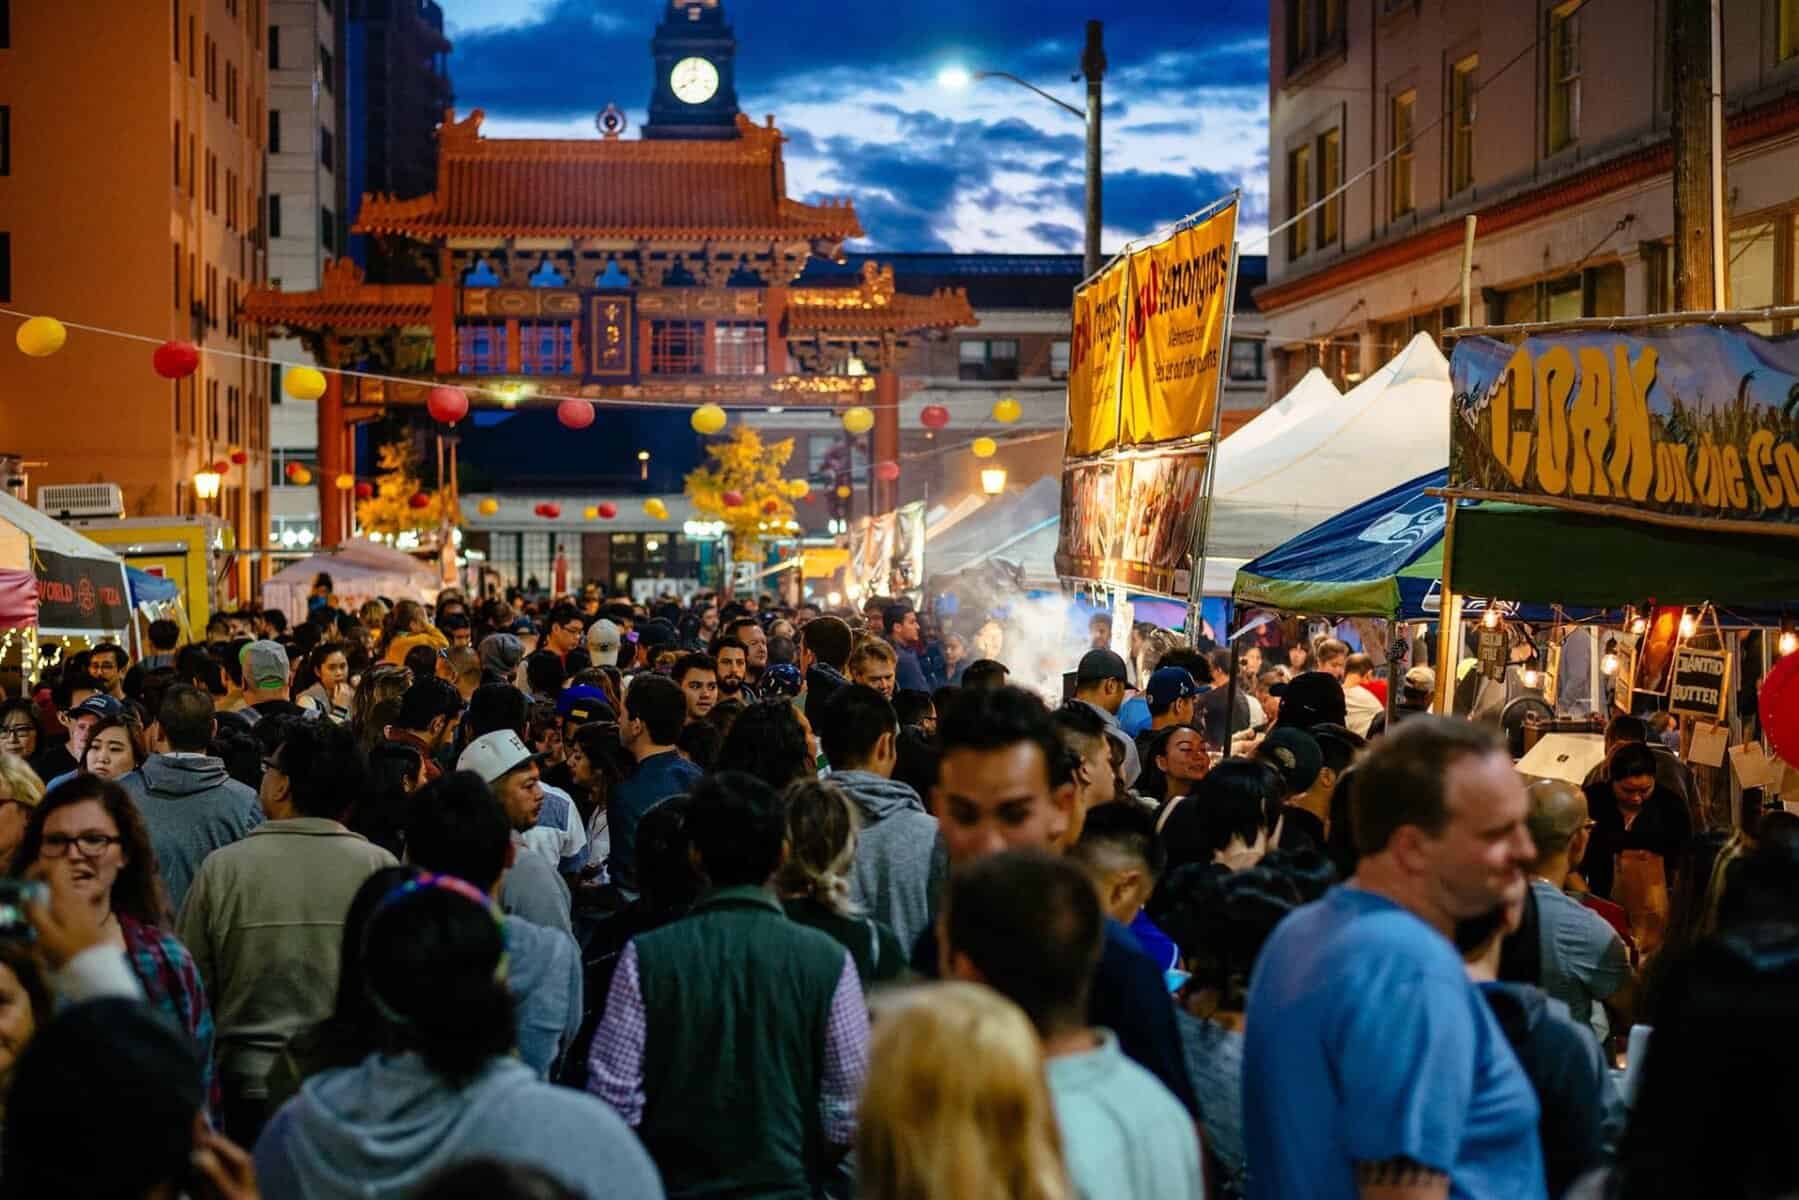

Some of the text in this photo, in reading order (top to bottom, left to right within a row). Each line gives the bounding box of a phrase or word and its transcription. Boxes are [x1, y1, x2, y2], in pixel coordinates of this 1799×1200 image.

[1491, 343, 1658, 501] CORN
[1655, 440, 1694, 504] on
[1694, 430, 1748, 510] the
[35, 580, 74, 604] WORLD
